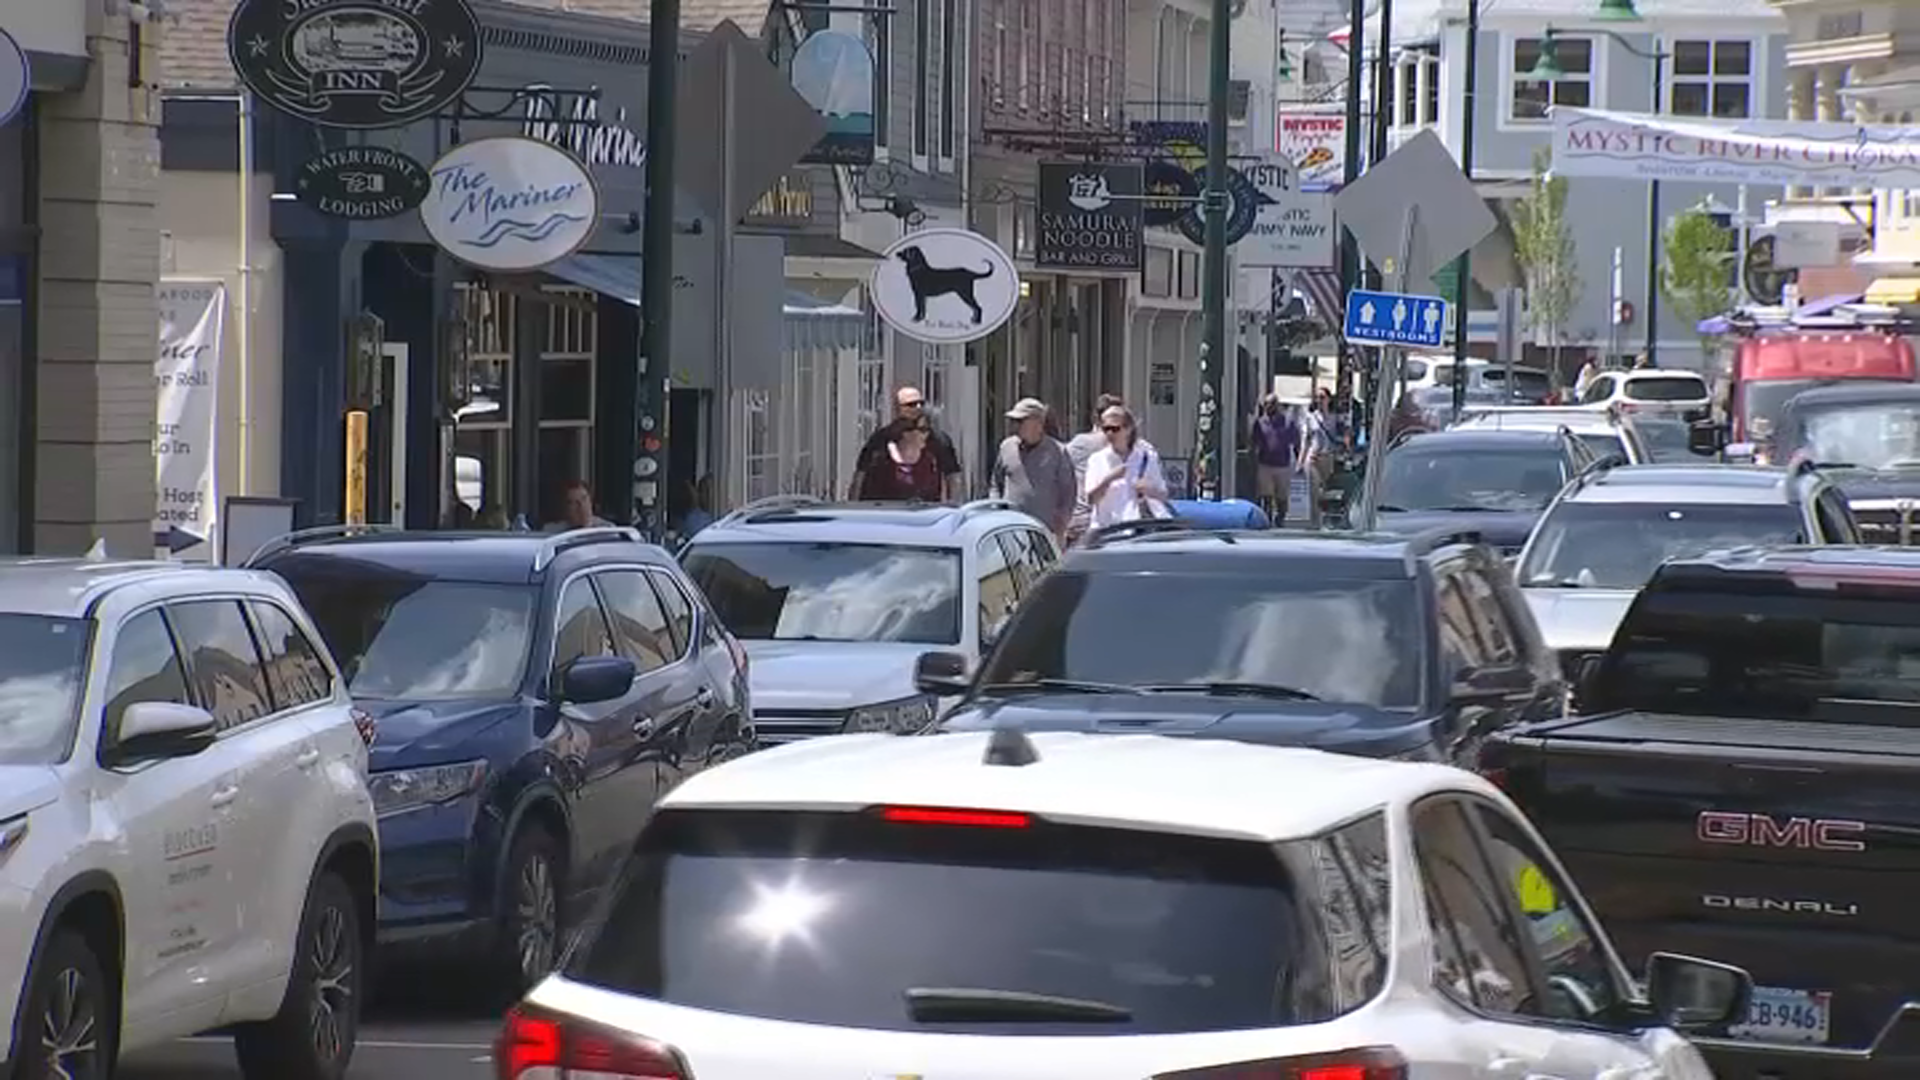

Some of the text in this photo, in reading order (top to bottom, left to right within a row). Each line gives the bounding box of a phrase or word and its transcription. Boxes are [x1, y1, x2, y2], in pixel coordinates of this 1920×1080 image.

[324, 73, 384, 90] INN
[567, 84, 648, 169] Marine
[1284, 118, 1344, 131] MYSTIC
[1567, 129, 1918, 166] MYSTIC RIVER CHORA
[305, 149, 416, 176] WATER FRONT
[431, 162, 490, 200] The
[1244, 164, 1290, 191] YSTIC
[319, 195, 405, 217] LODGING
[450, 183, 582, 224] Mariner
[1042, 213, 1138, 232] SAMURAI
[1289, 224, 1326, 237] NAVY
[1045, 231, 1135, 249] NOODLE
[1041, 250, 1137, 266] BAR AND GRILL
[160, 289, 214, 301] AFOOD
[1354, 327, 1438, 343] RESTROOMS
[176, 370, 209, 387] Roll
[173, 440, 191, 455] In
[164, 487, 204, 503] Host
[158, 507, 199, 522] ated
[1697, 811, 1866, 851] GMC
[1703, 895, 1859, 915] DENALI
